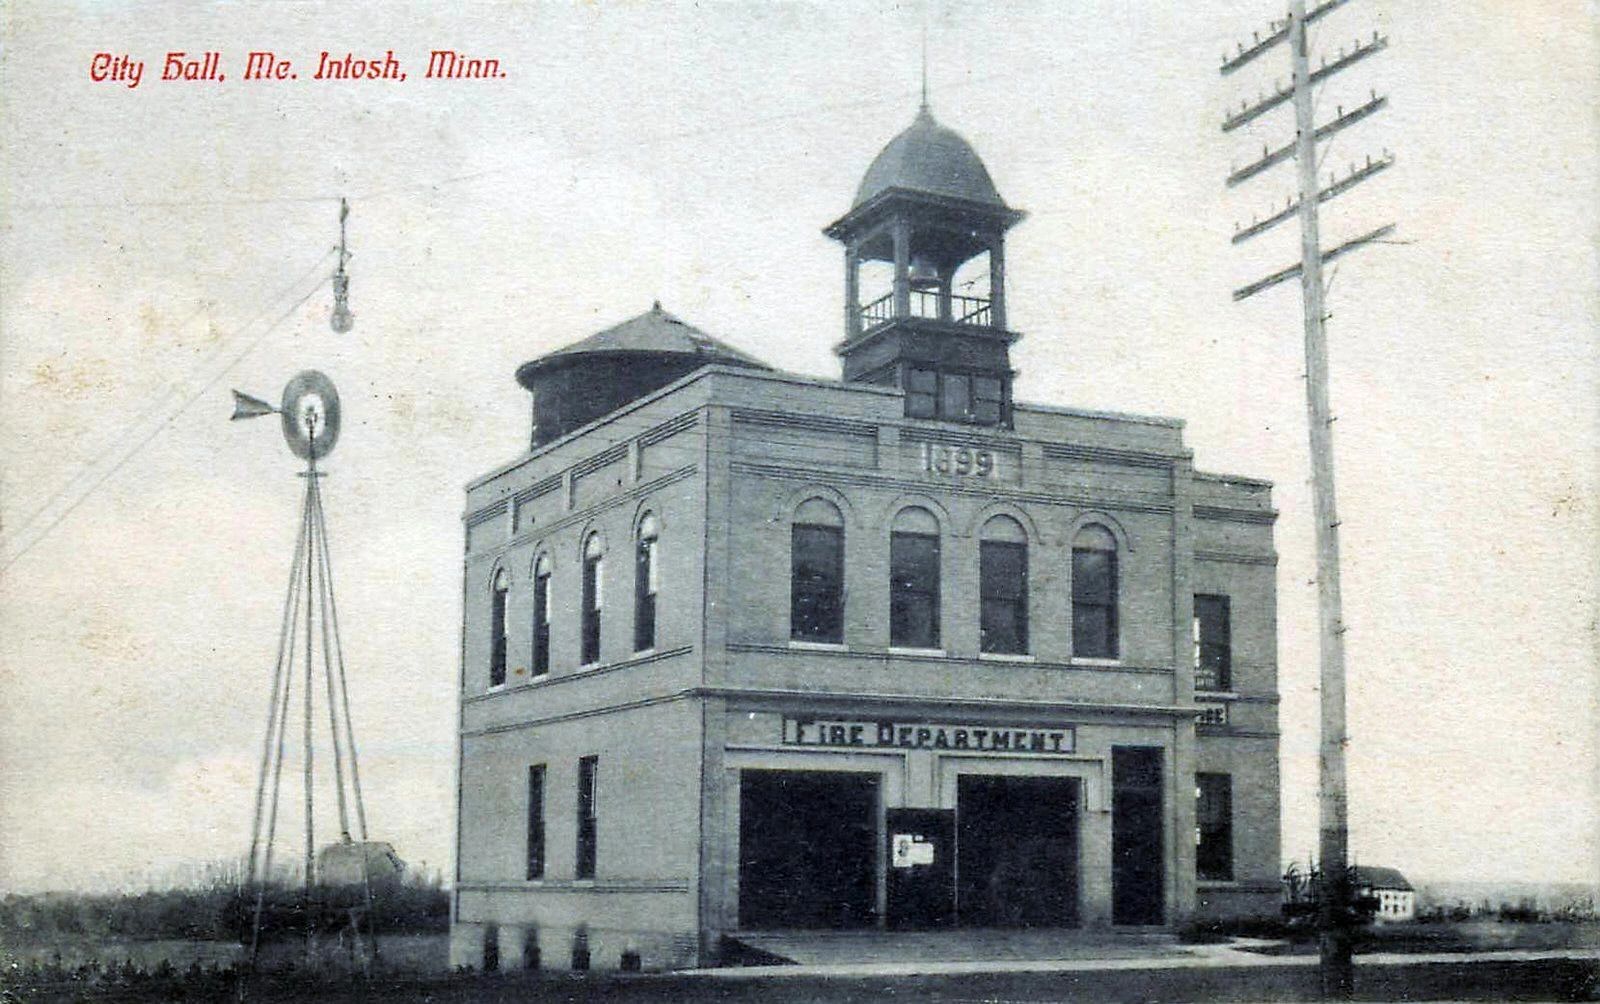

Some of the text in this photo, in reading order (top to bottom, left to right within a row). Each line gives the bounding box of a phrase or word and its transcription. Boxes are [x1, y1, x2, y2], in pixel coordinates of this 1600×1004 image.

[923, 442, 994, 477] 1899
[797, 720, 1064, 750] FIRE DEPARTMENT
